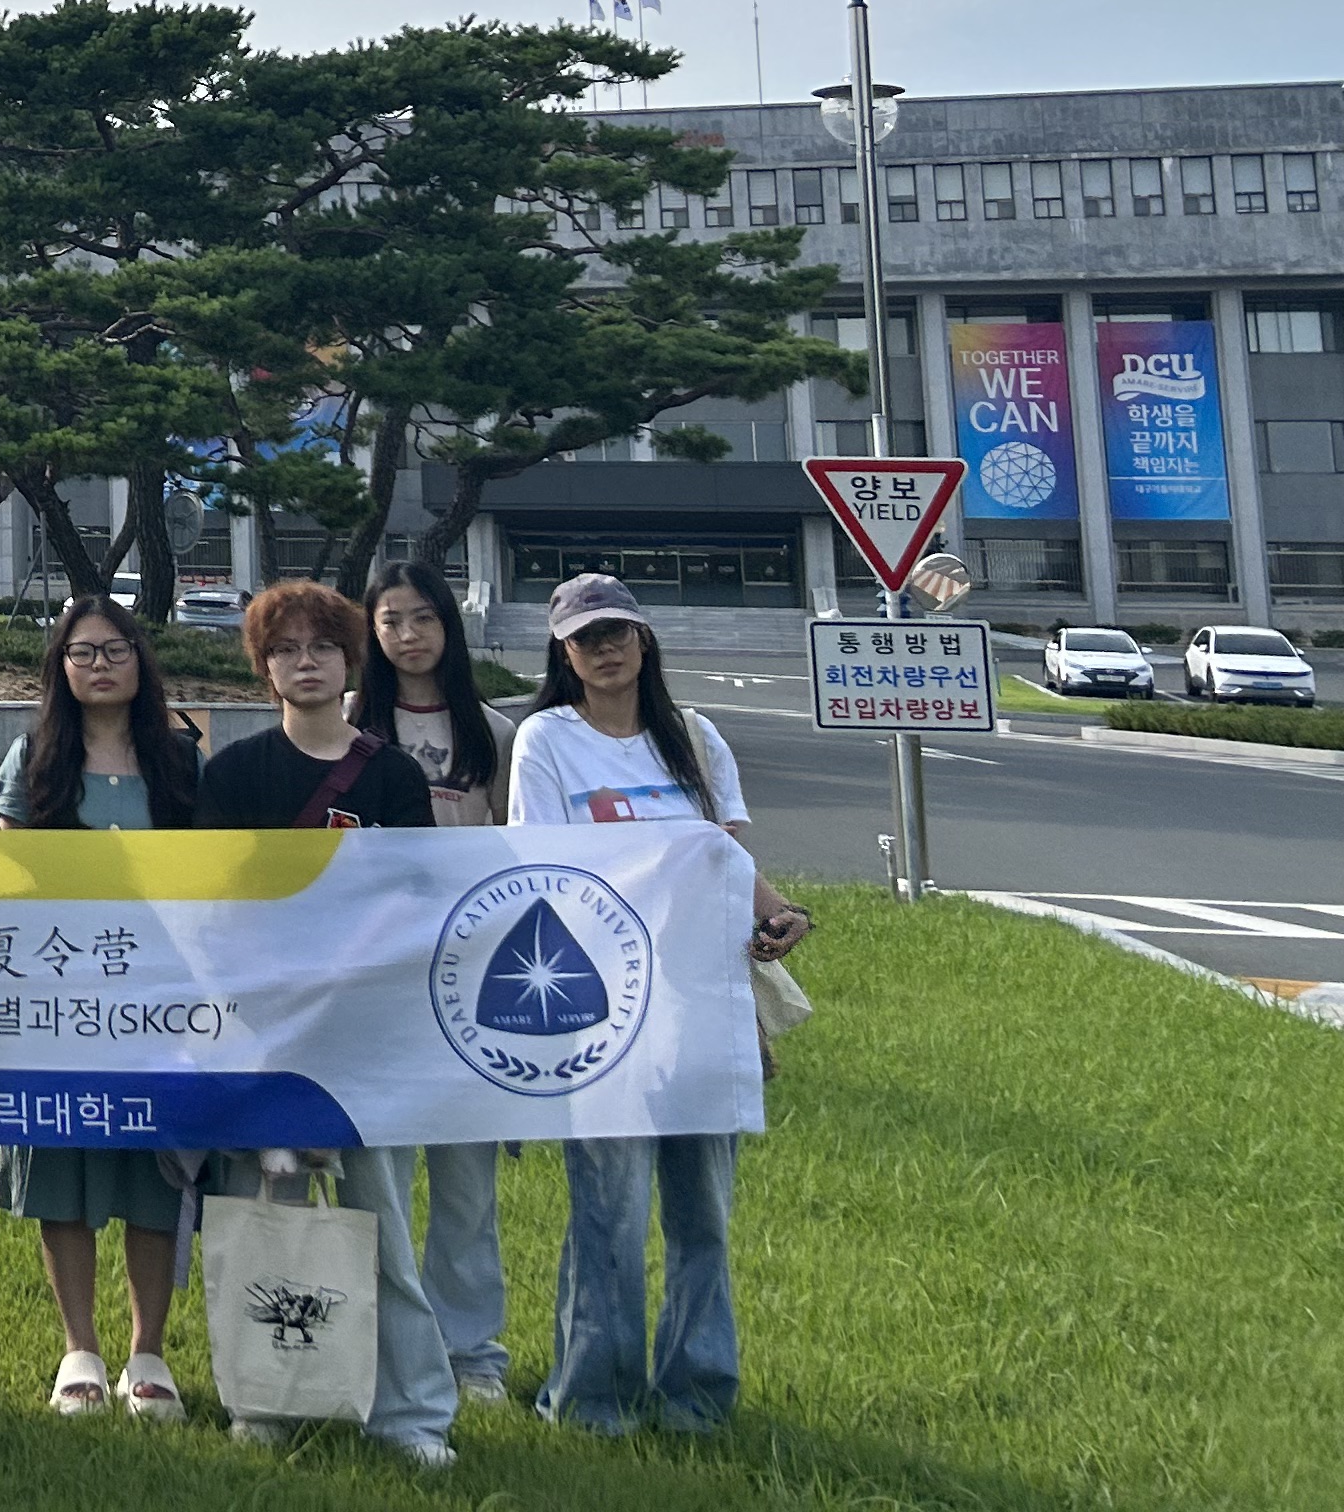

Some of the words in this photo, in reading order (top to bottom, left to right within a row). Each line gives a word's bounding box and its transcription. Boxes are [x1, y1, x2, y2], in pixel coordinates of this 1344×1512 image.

[960, 349, 1060, 365] TOGETHER
[1122, 353, 1201, 380] DCU
[978, 367, 1044, 399] WE
[969, 401, 1059, 433] CAN
[1127, 404, 1197, 427] 학생을
[1130, 431, 1199, 454] 끝까지
[1132, 456, 1200, 474] 책임지는
[851, 475, 921, 501] 양보
[853, 503, 921, 521] YIELD
[825, 664, 979, 689] 회전차량우선
[828, 697, 982, 720] 진입차량양보
[431, 790, 464, 802] OVELY
[455, 876, 570, 940] CATHOLIC
[580, 886, 641, 1035] UNIVERSITY
[441, 953, 478, 1045] DAEGU
